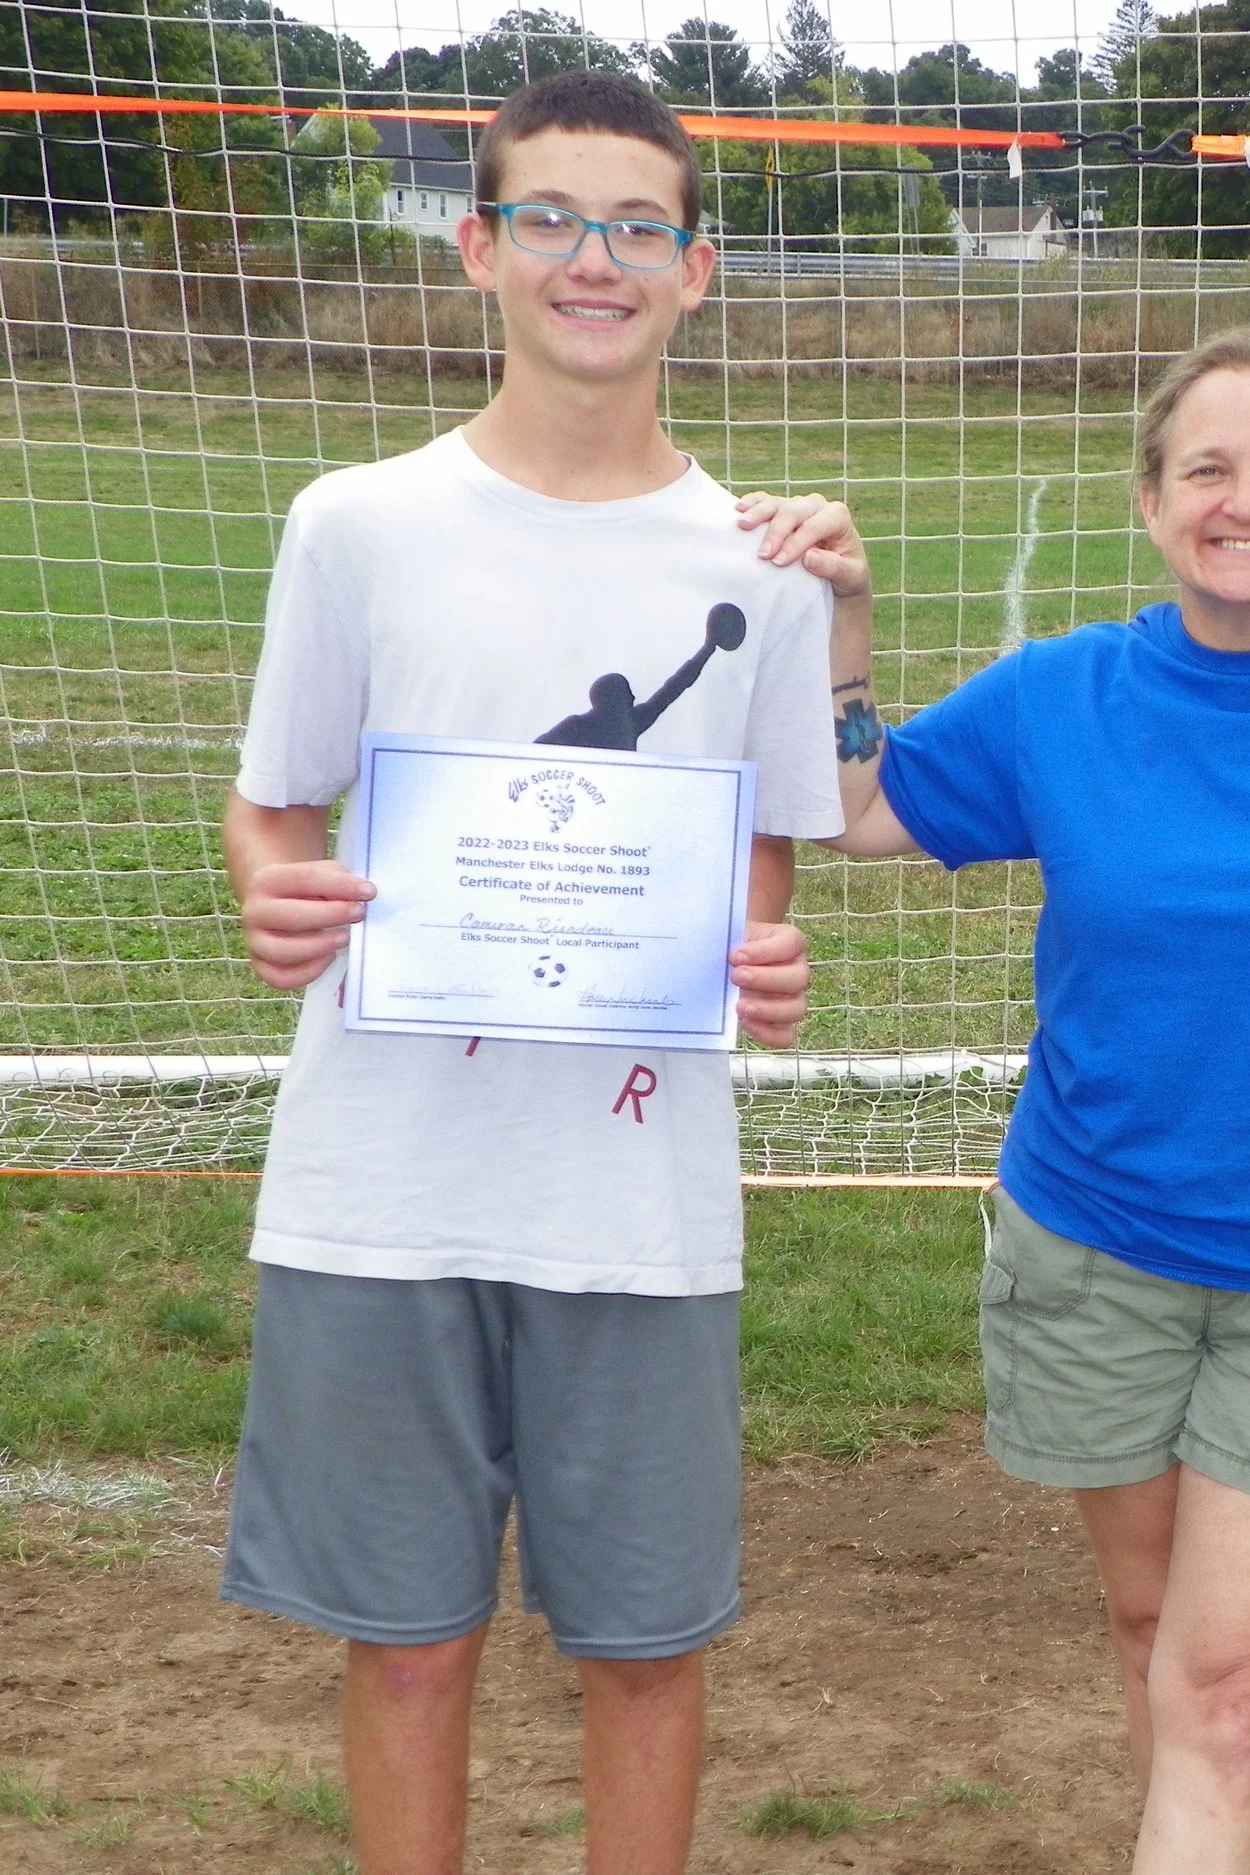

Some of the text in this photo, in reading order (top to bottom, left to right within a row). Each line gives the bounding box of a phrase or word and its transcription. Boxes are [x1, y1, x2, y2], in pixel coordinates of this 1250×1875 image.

[508, 769, 606, 805] Elks SOCCER SHOOT
[457, 836, 529, 851] 2022-2023
[533, 841, 560, 853] Elks
[563, 843, 606, 855] Soccer
[455, 856, 651, 876] Manchester Elks Lodge No. 1893
[459, 875, 645, 896] Certificate of Achievement
[519, 894, 584, 906] Presented to
[460, 932, 482, 942] Elks
[484, 934, 519, 944] Soccer
[556, 937, 582, 947] Local
[585, 939, 640, 950] Participant
